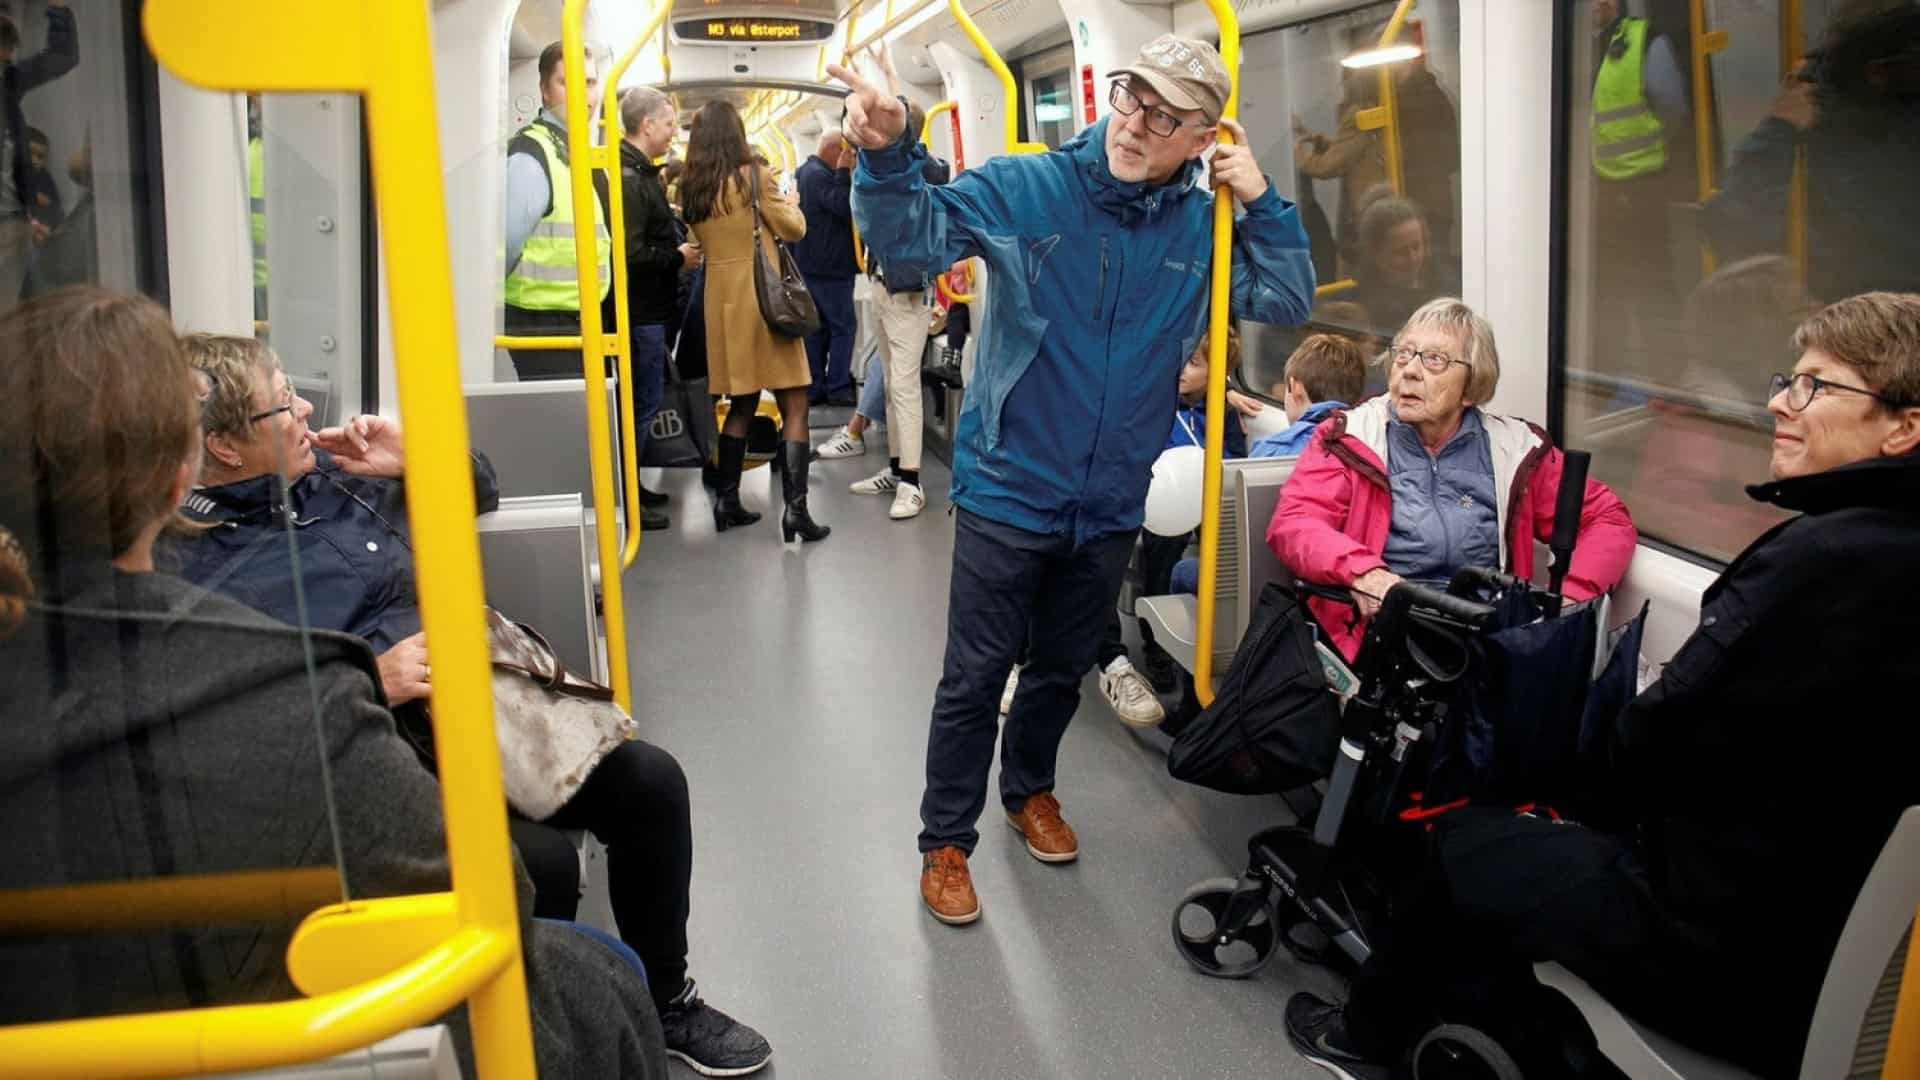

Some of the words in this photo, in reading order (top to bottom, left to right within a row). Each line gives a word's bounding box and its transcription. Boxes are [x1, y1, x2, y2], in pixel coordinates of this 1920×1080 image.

[708, 23, 725, 36] M3
[730, 23, 746, 36] via
[750, 23, 800, 37] Østerport
[1188, 57, 1206, 79] 66
